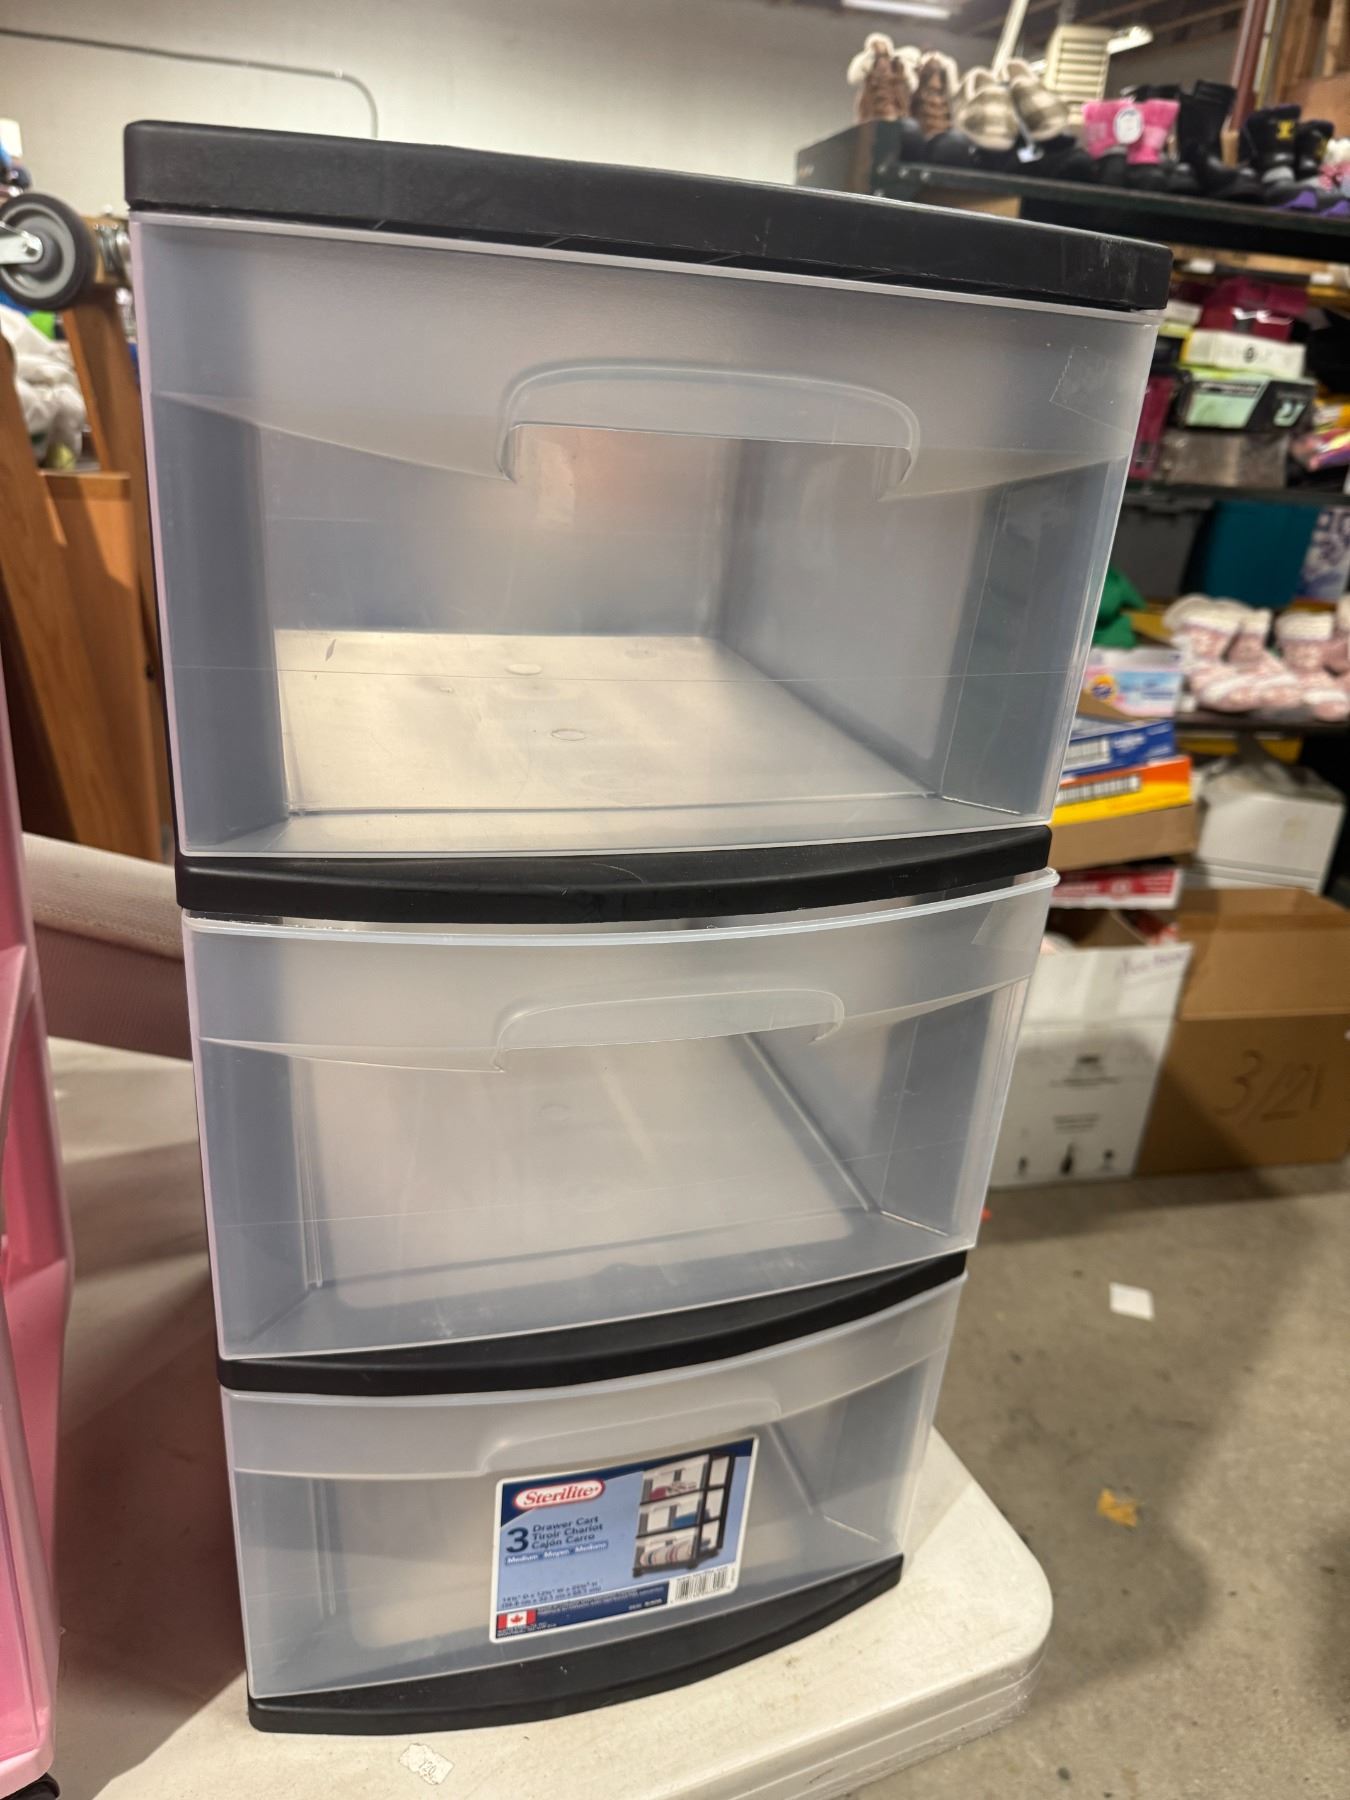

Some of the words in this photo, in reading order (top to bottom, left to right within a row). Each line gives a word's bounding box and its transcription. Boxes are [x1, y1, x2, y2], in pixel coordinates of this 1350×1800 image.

[524, 1483, 594, 1506] Sterilite
[532, 1520, 572, 1533] Drawer
[576, 1515, 599, 1526] Cart
[532, 1530, 560, 1541] Tiroir
[564, 1523, 604, 1536] Chariot
[506, 1527, 529, 1553] 3
[566, 1533, 596, 1545] Carro
